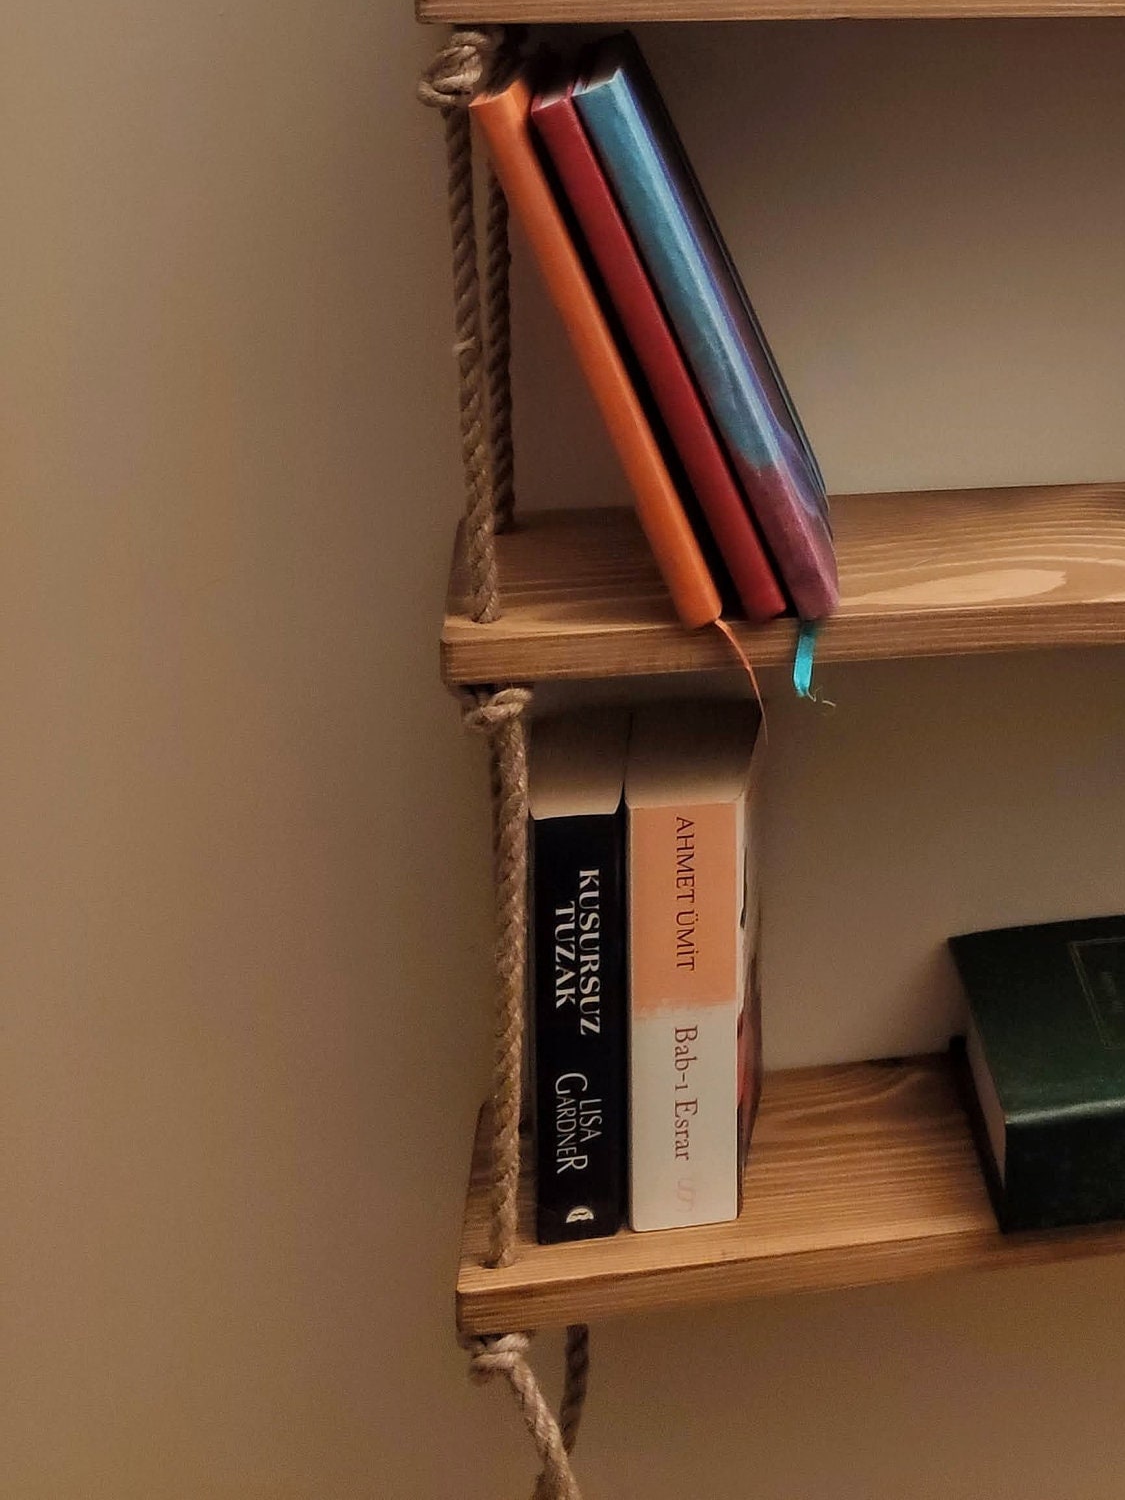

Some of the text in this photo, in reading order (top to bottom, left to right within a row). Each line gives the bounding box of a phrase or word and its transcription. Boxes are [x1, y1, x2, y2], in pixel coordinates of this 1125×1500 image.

[554, 900, 576, 1009] TUZAK
[579, 868, 600, 1035] KUSURSUZ
[675, 816, 699, 972] AHMET ÜMİT
[555, 1072, 588, 1174] GARDNER
[579, 1098, 602, 1143] LISA
[674, 1024, 698, 1161] Bab-ı Esrar
